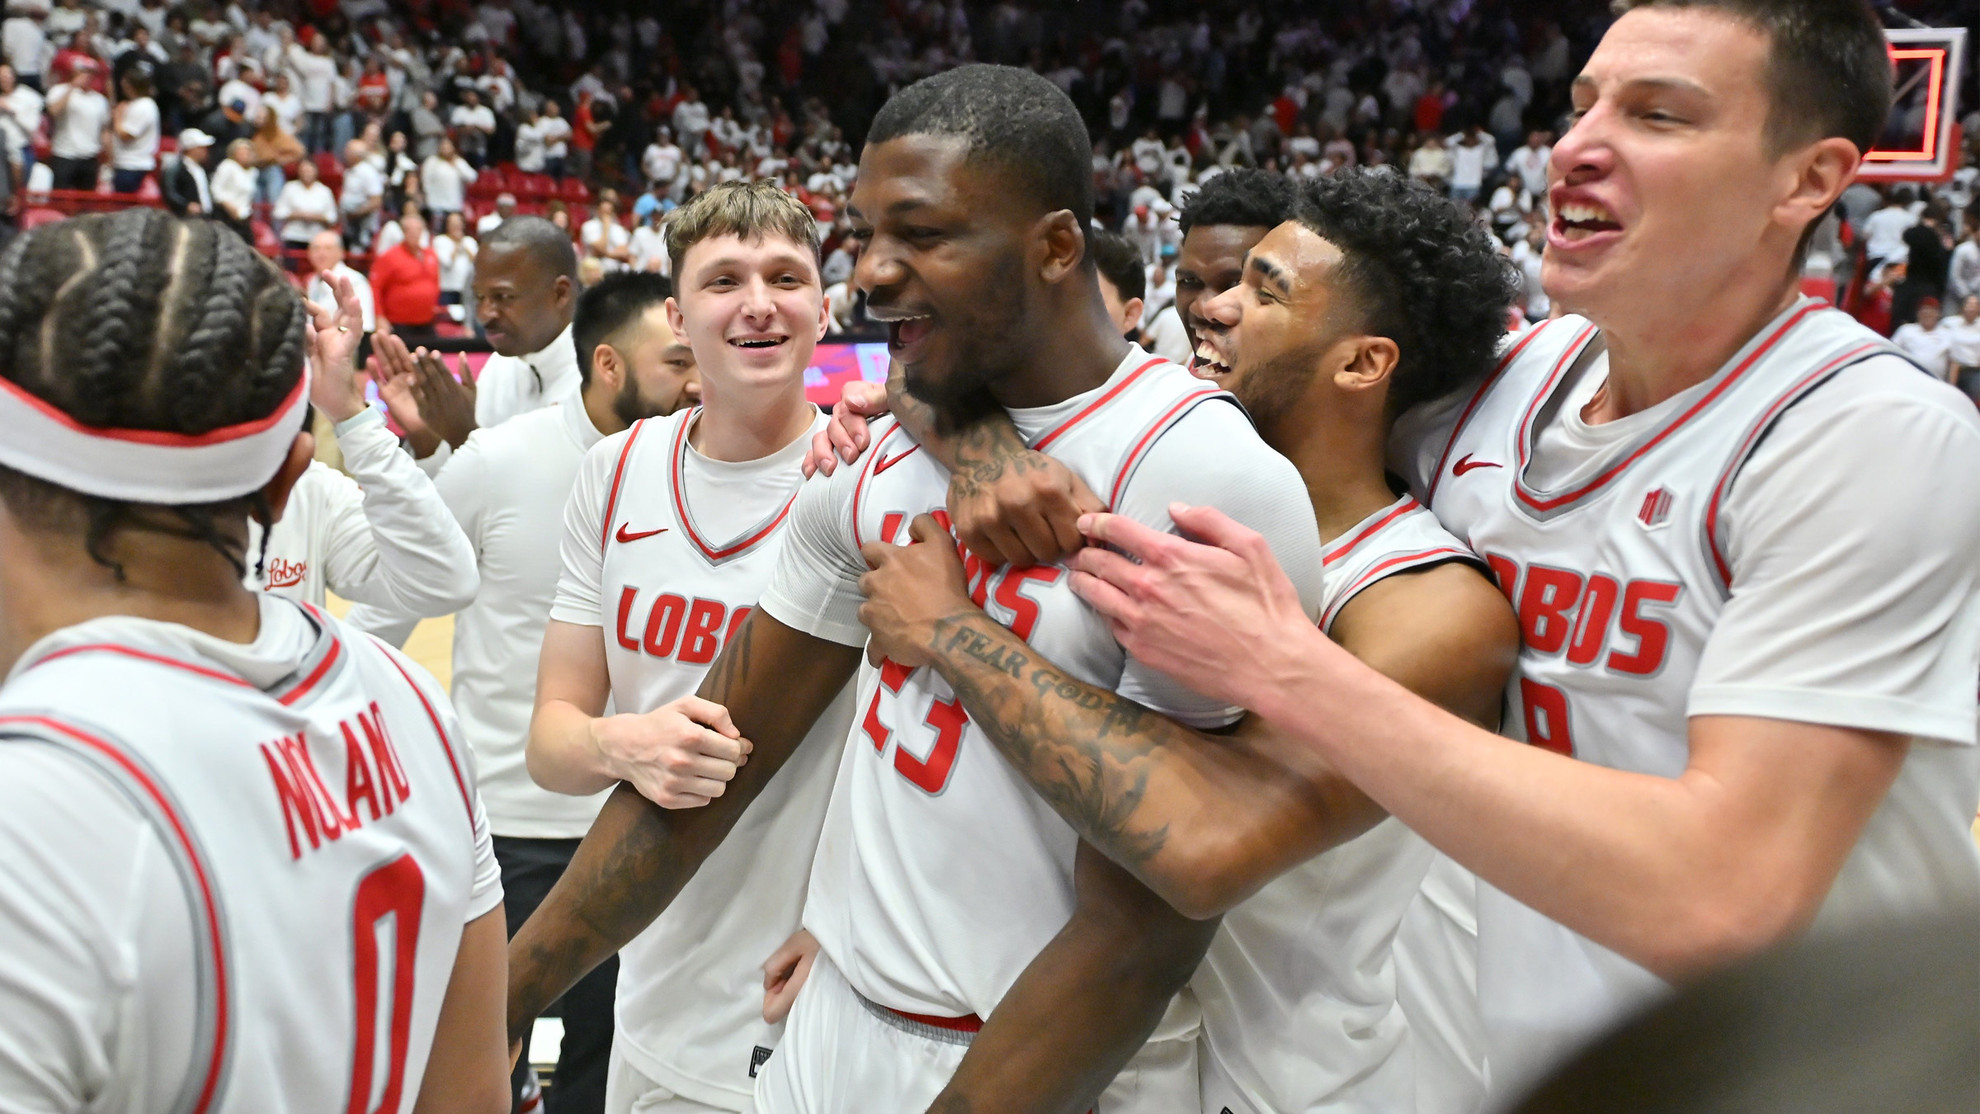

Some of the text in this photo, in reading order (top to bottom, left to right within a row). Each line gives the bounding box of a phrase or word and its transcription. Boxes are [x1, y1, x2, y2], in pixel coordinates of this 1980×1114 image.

[945, 625, 1103, 710] FEAR GOD
[344, 846, 428, 1114] 0
